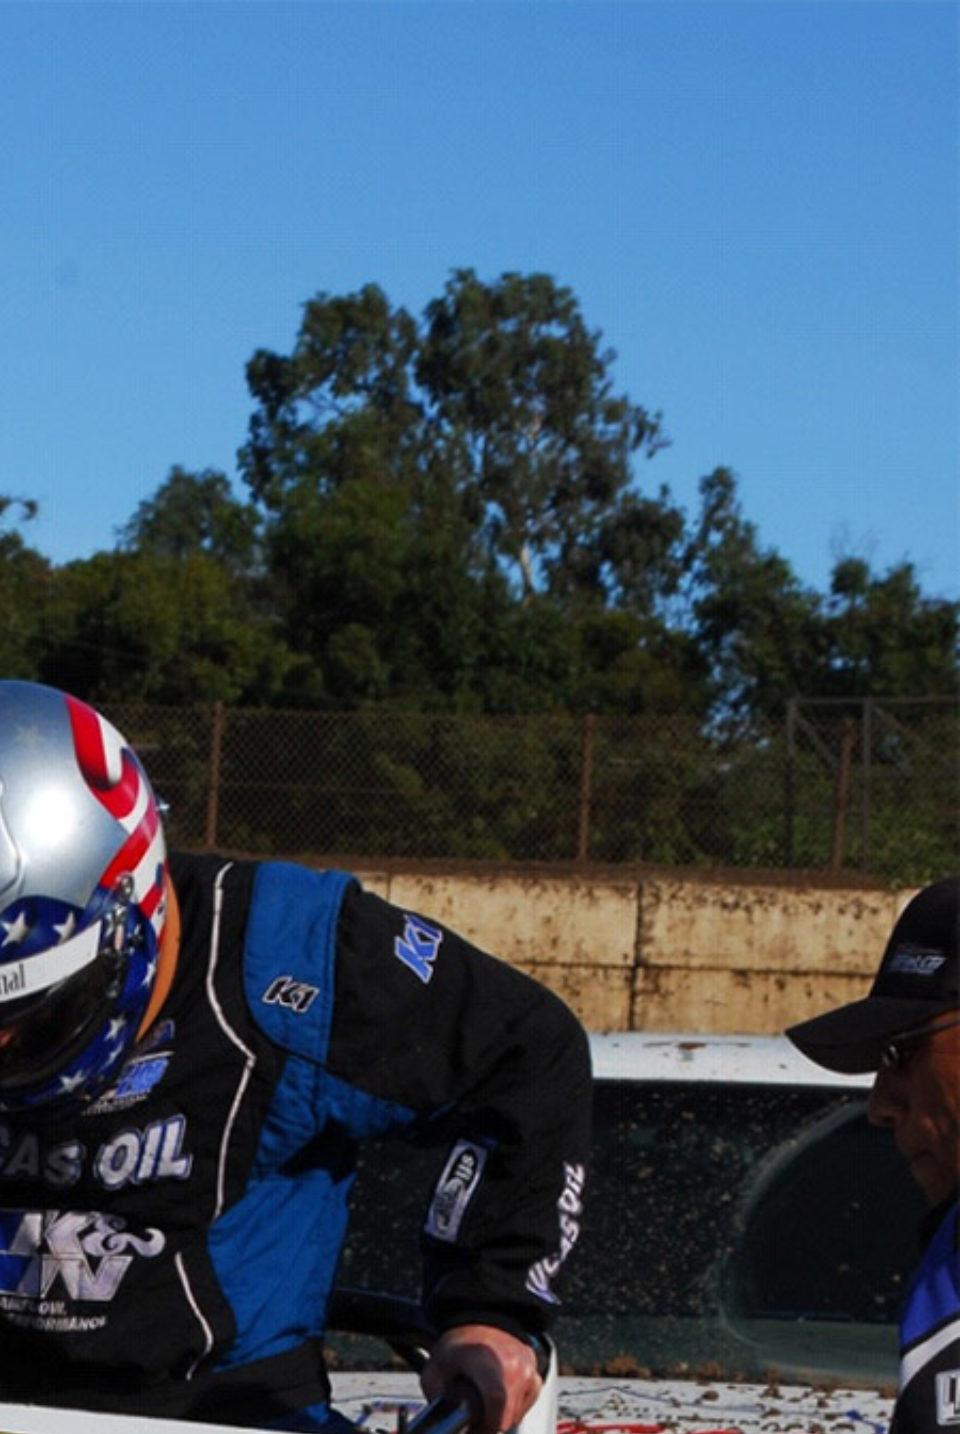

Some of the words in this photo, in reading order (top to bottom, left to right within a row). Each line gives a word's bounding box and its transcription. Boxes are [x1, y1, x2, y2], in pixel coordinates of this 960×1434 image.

[394, 912, 444, 985] K1
[262, 975, 320, 1013] K1
[94, 1113, 193, 1190] OIL
[557, 1160, 586, 1217] OIL
